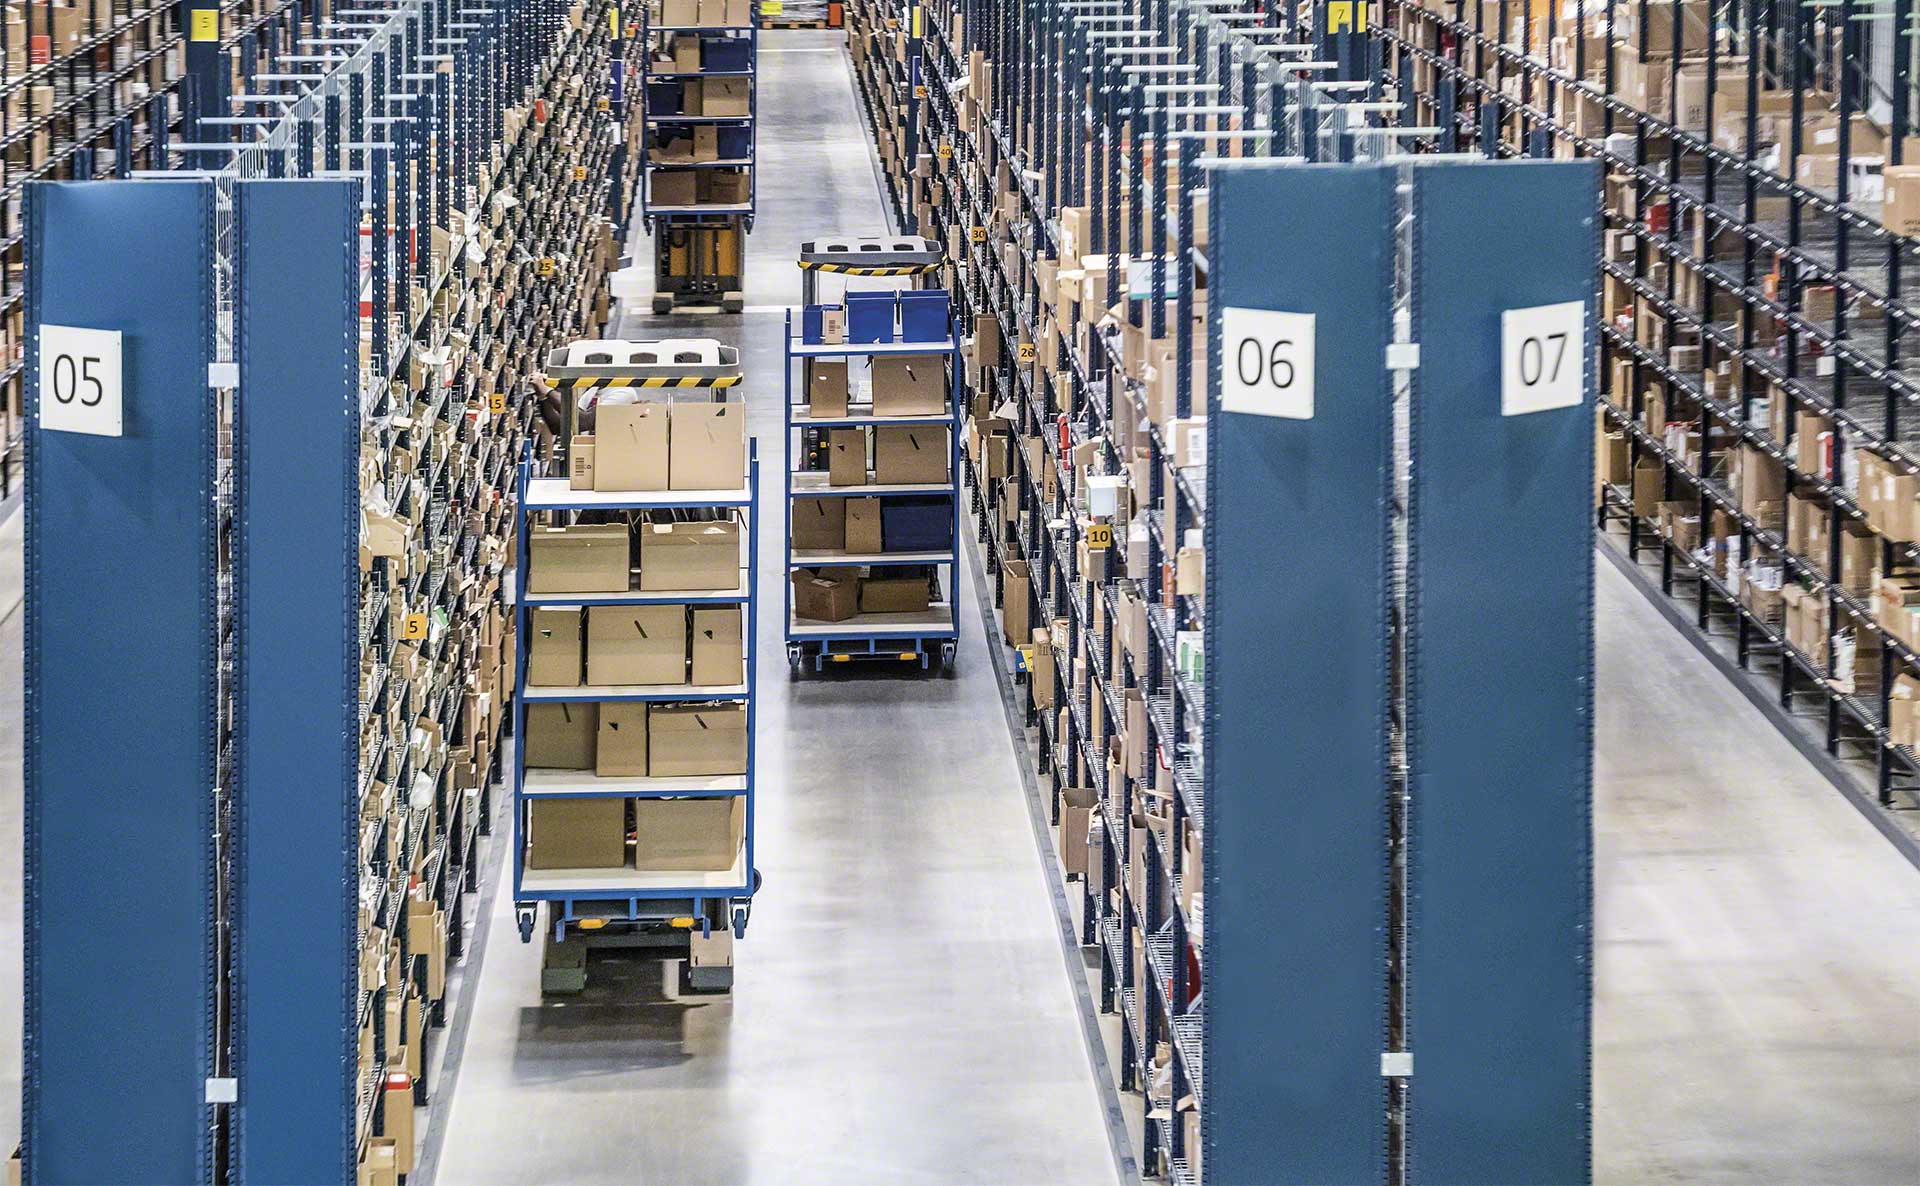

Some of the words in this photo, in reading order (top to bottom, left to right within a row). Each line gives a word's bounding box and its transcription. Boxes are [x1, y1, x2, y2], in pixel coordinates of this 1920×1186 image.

[973, 229, 985, 239] 30
[538, 262, 551, 272] 25
[1238, 337, 1294, 390] 06
[1520, 331, 1568, 388] 07
[53, 353, 103, 408] 05
[489, 399, 502, 409] 15
[1091, 530, 1109, 543] 10
[410, 621, 418, 633] 5
